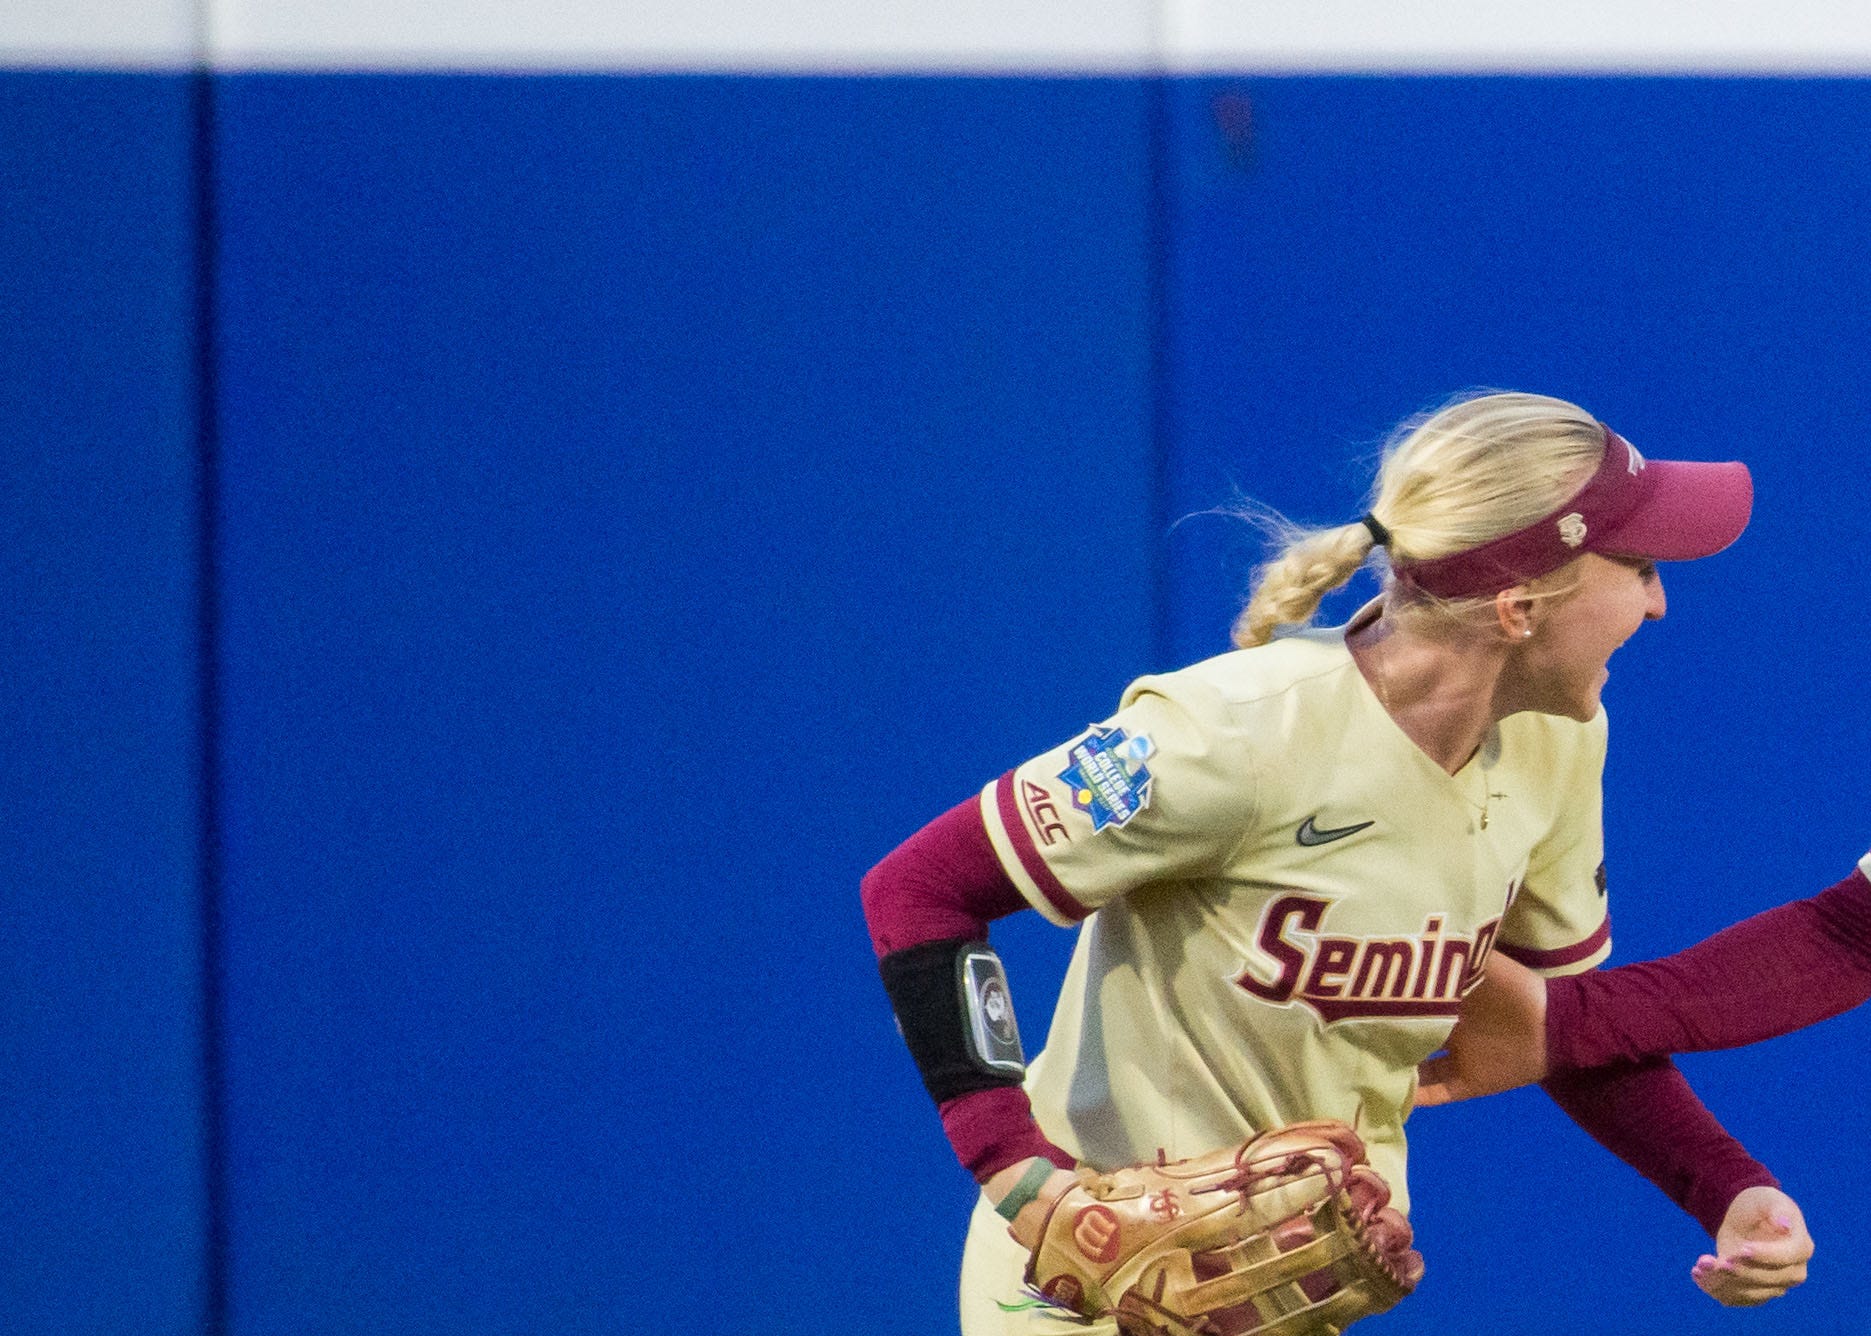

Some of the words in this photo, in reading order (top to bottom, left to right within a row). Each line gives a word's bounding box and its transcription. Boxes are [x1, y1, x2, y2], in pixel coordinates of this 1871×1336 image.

[1074, 744, 1105, 785] WORLD
[1101, 781, 1131, 820] SERIES
[1095, 751, 1130, 797] COLLEGE
[1022, 779, 1071, 846] ACC
[1234, 882, 1514, 1020] Semino
